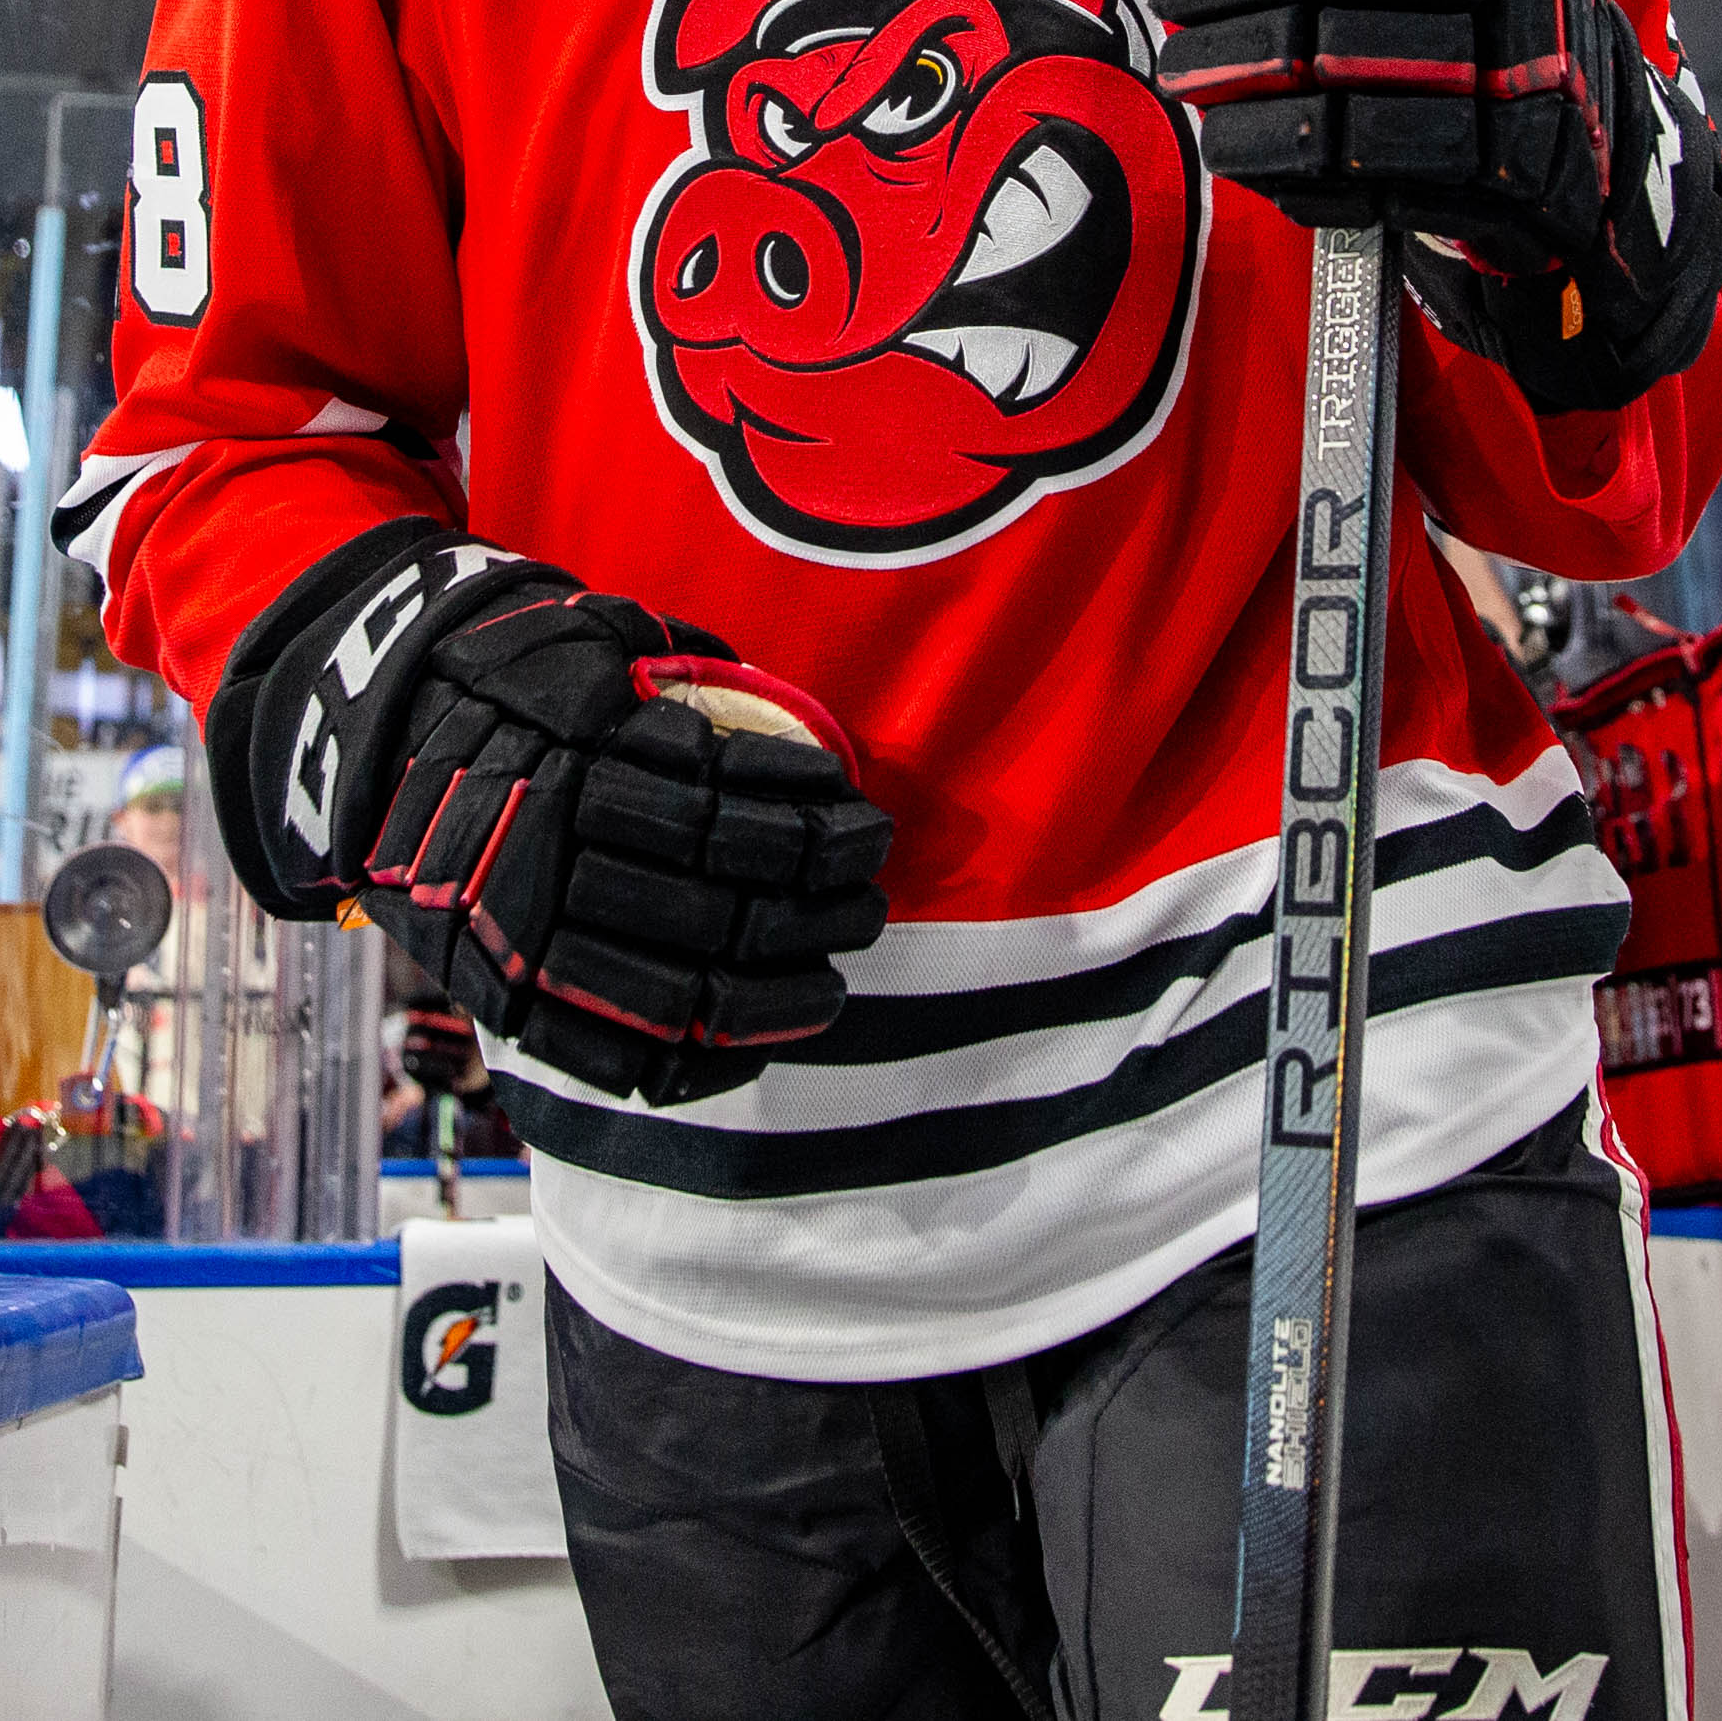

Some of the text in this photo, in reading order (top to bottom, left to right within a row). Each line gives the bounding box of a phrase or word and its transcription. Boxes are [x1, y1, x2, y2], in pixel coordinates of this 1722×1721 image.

[129, 69, 215, 329] 8
[1318, 228, 1363, 462] TRIGGER
[1271, 486, 1366, 1151] RIBCOR
[1265, 1317, 1291, 1487] NANOLITE
[1282, 1319, 1313, 1491] SHIELD
